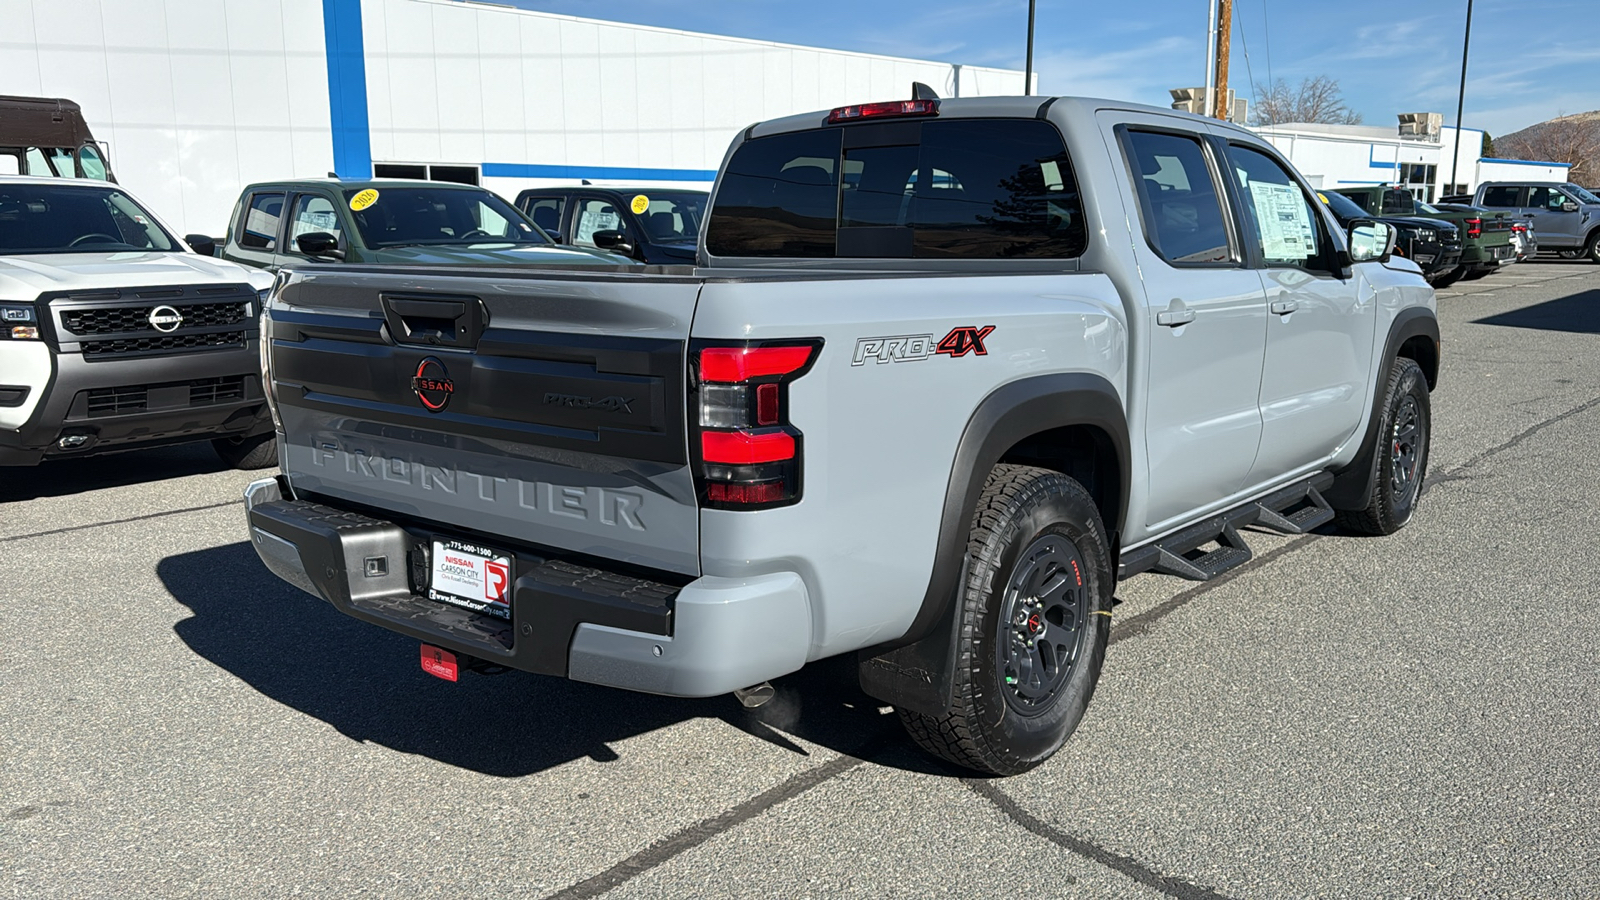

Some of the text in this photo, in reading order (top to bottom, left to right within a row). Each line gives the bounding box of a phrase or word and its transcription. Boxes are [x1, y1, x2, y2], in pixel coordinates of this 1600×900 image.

[354, 190, 375, 207] 2026
[851, 325, 996, 367] PRO-4X
[310, 434, 647, 532] FRONTIER
[450, 541, 492, 557] 775-600-1500
[445, 556, 474, 568] NISSAN
[441, 563, 479, 579] CARSON CITY
[436, 593, 504, 615] www.NissanCarsonCity.com
